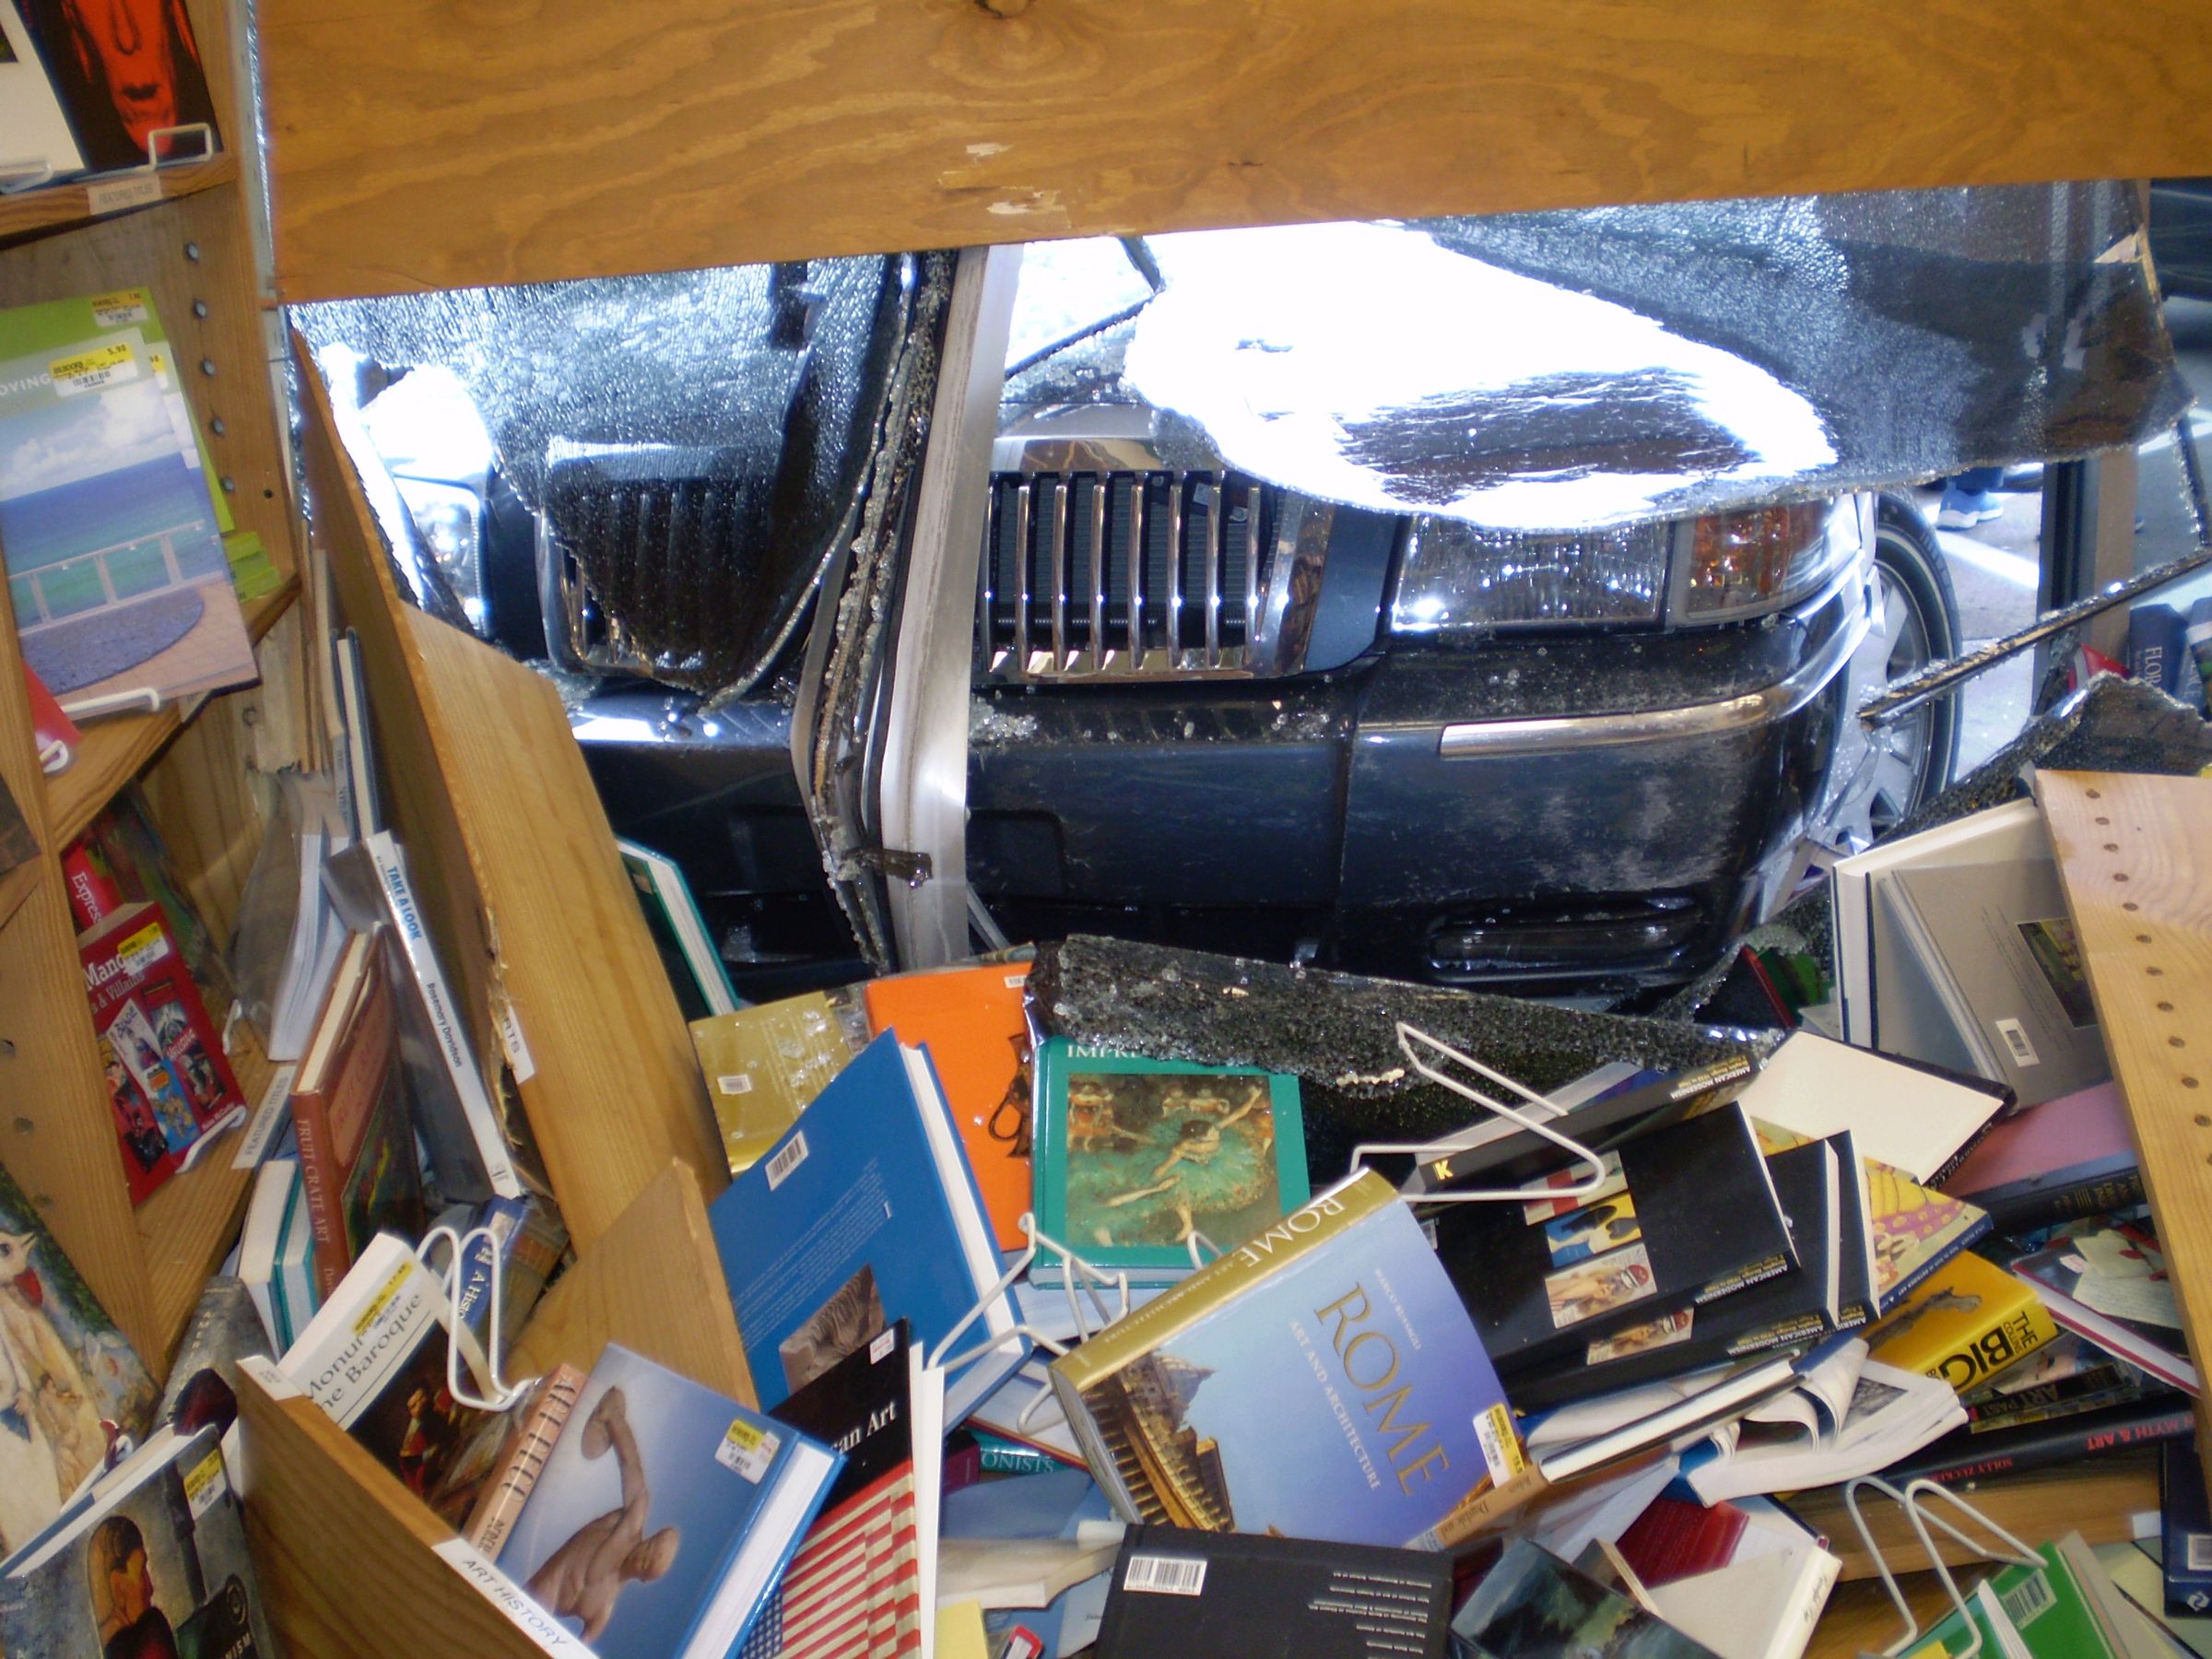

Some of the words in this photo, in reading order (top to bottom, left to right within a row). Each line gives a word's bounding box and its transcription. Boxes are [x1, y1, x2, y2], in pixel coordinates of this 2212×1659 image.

[387, 865, 406, 900] TAKE
[398, 896, 409, 909] A
[401, 906, 422, 942] LOOK
[427, 982, 448, 1029] Rosemary
[441, 1025, 463, 1068] Davidson
[1669, 1078, 1714, 1099] MODERNISM
[1713, 1065, 1751, 1083] AMERICAN
[245, 1107, 276, 1155] FEATURED
[297, 1119, 315, 1161] FRUIT
[304, 1163, 324, 1210] CRATE
[313, 1217, 330, 1243] ART
[1232, 1196, 1347, 1268] ROME
[473, 1269, 486, 1285] A
[1375, 1267, 1398, 1305] MARCO
[1694, 1280, 1745, 1304] MODERNISM
[1745, 1264, 1789, 1285] AMERICAN
[344, 1294, 421, 1385] Baroque
[1726, 1335, 1778, 1357] MODERNISM
[1780, 1323, 1824, 1342] AMERICAN
[2003, 1321, 2022, 1355] COLLINS
[2012, 1310, 2039, 1349] THE
[1938, 1326, 2015, 1389] BIG
[1289, 1319, 1312, 1348] ART
[1306, 1349, 1328, 1384] AND
[1324, 1384, 1381, 1492] ARCHITECTURE
[1313, 1281, 1450, 1497] ROME
[866, 1399, 897, 1437] Art
[2117, 1428, 2132, 1443] &
[2134, 1418, 2179, 1439] MYTH
[2085, 1431, 2115, 1451] ART
[500, 1430, 552, 1503] DECO
[1977, 1457, 2014, 1474] SOLLY
[461, 1558, 499, 1584] ART
[494, 1582, 570, 1647] HISTORY
